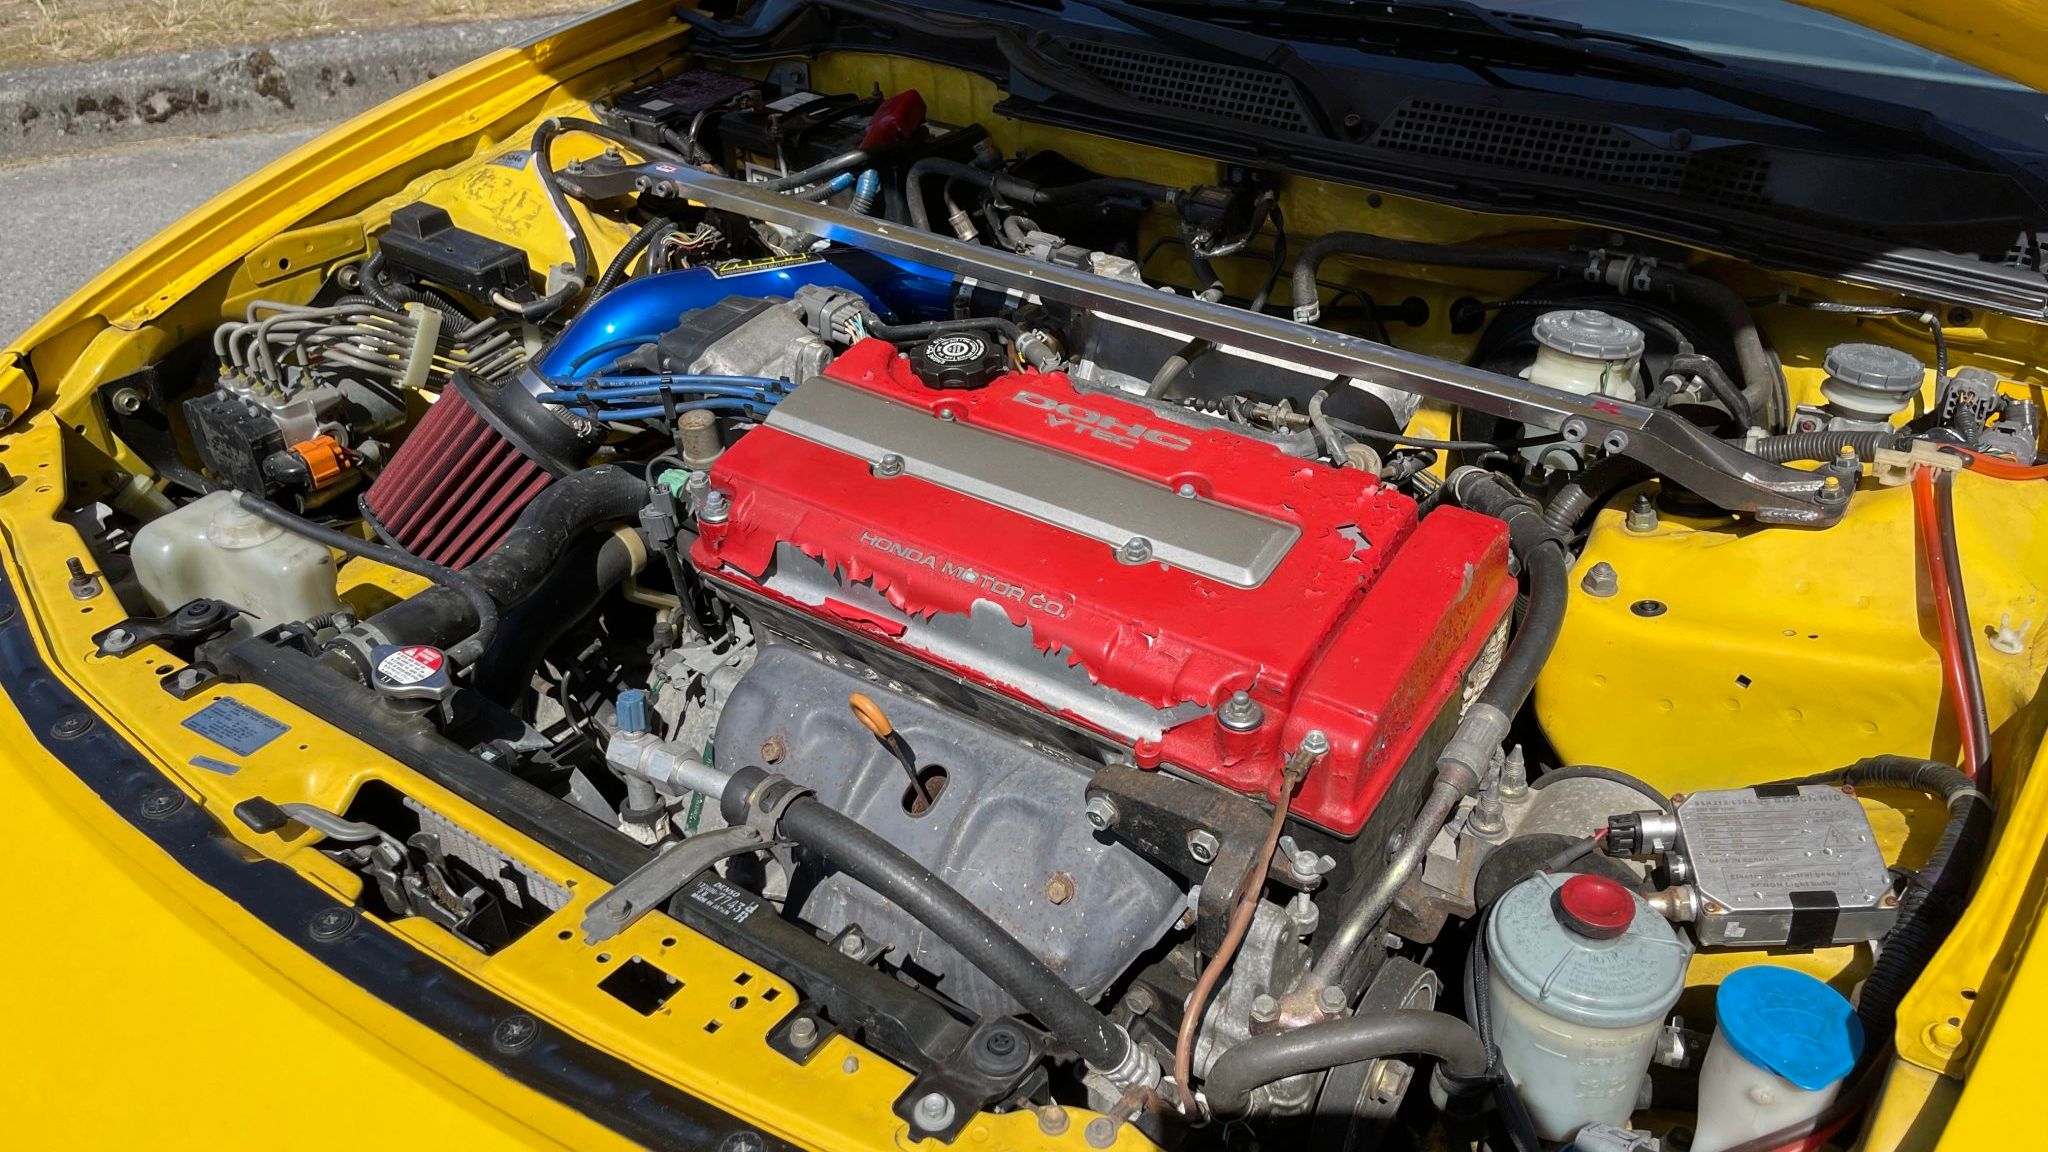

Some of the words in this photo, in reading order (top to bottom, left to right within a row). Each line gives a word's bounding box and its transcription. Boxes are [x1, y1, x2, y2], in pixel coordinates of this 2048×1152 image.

[1012, 389, 1192, 452] DOHC
[1047, 412, 1140, 451] VTEC
[859, 530, 938, 570] HONDA
[941, 561, 1026, 602] MOTOR
[1028, 592, 1067, 619] CO.
[1820, 793, 1842, 803] HID
[713, 882, 741, 898] DENSO
